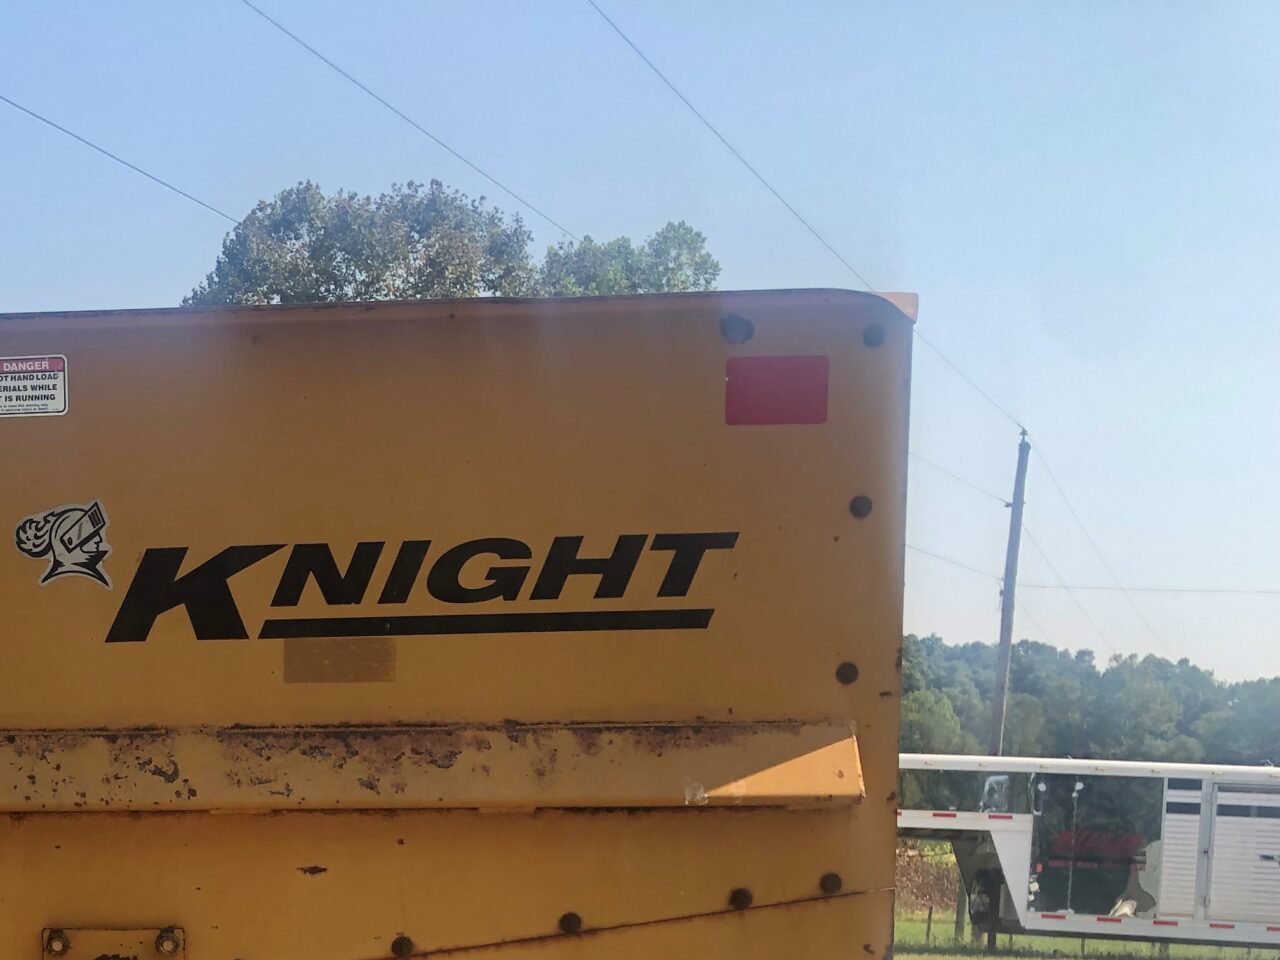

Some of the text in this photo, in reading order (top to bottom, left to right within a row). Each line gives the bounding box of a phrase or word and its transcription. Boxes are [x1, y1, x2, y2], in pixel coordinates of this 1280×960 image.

[2, 361, 50, 372] DANGER
[10, 374, 35, 382] HAND
[36, 373, 59, 381] LOAD
[15, 394, 56, 402] RUNNING
[104, 531, 740, 642] KNIGHT
